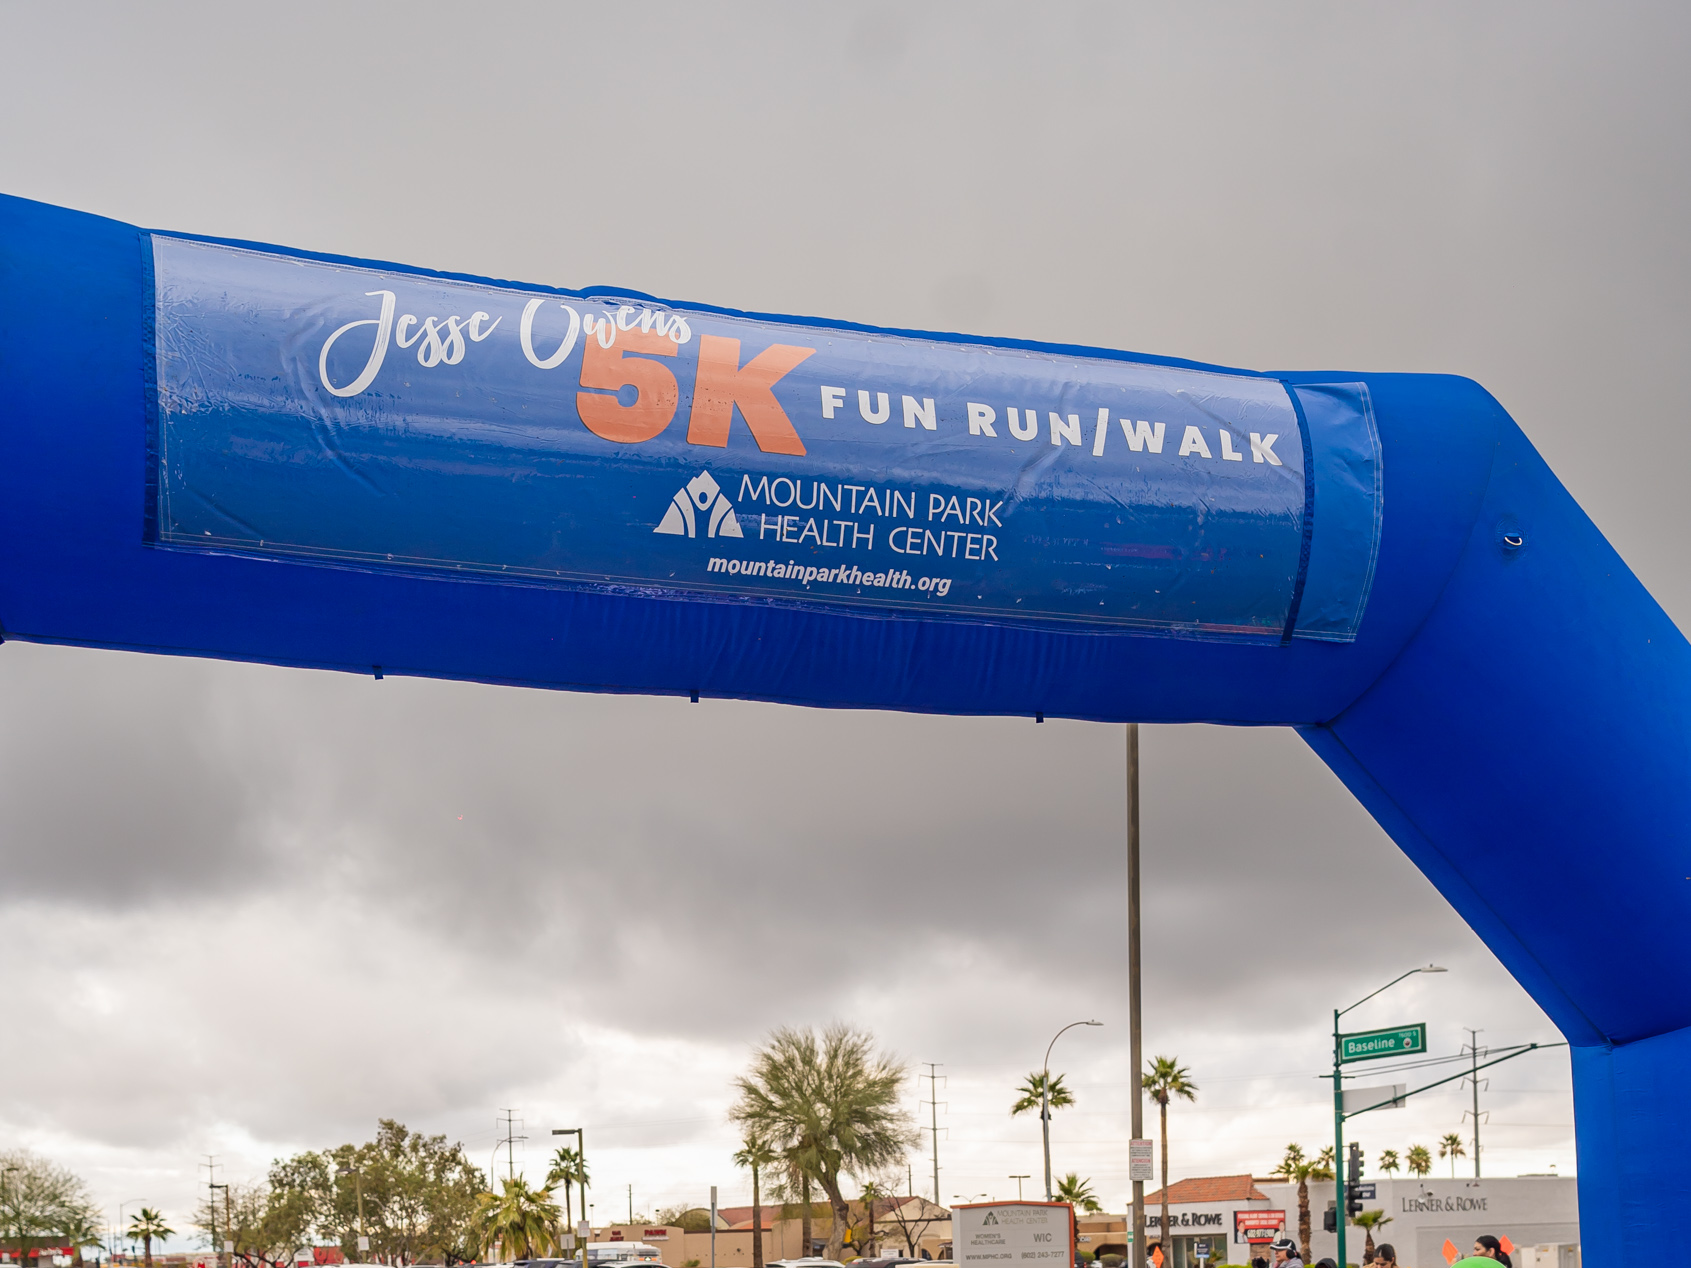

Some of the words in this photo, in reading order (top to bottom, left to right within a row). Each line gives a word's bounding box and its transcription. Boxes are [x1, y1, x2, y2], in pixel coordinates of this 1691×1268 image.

[319, 290, 502, 397] Jesse
[519, 298, 692, 369] Owens
[576, 322, 816, 457] 5K
[820, 385, 937, 430] FUN
[967, 401, 1282, 466] RUN/WALK
[738, 474, 916, 519] MOUNTAIN
[928, 493, 1004, 527] PARK
[760, 513, 875, 550] HEALTH
[889, 526, 999, 562] CENTER
[706, 556, 952, 596] mountainparkhealth.org
[1348, 1038, 1395, 1054] Baseline
[1144, 1214, 1181, 1228] LERER
[1181, 1212, 1191, 1227] &
[1191, 1212, 1223, 1226] ROWE
[1444, 1195, 1455, 1212] &
[1456, 1196, 1488, 1211] ROWE
[1021, 1251, 1036, 1259] (602)
[1033, 1233, 1052, 1243] WIC
